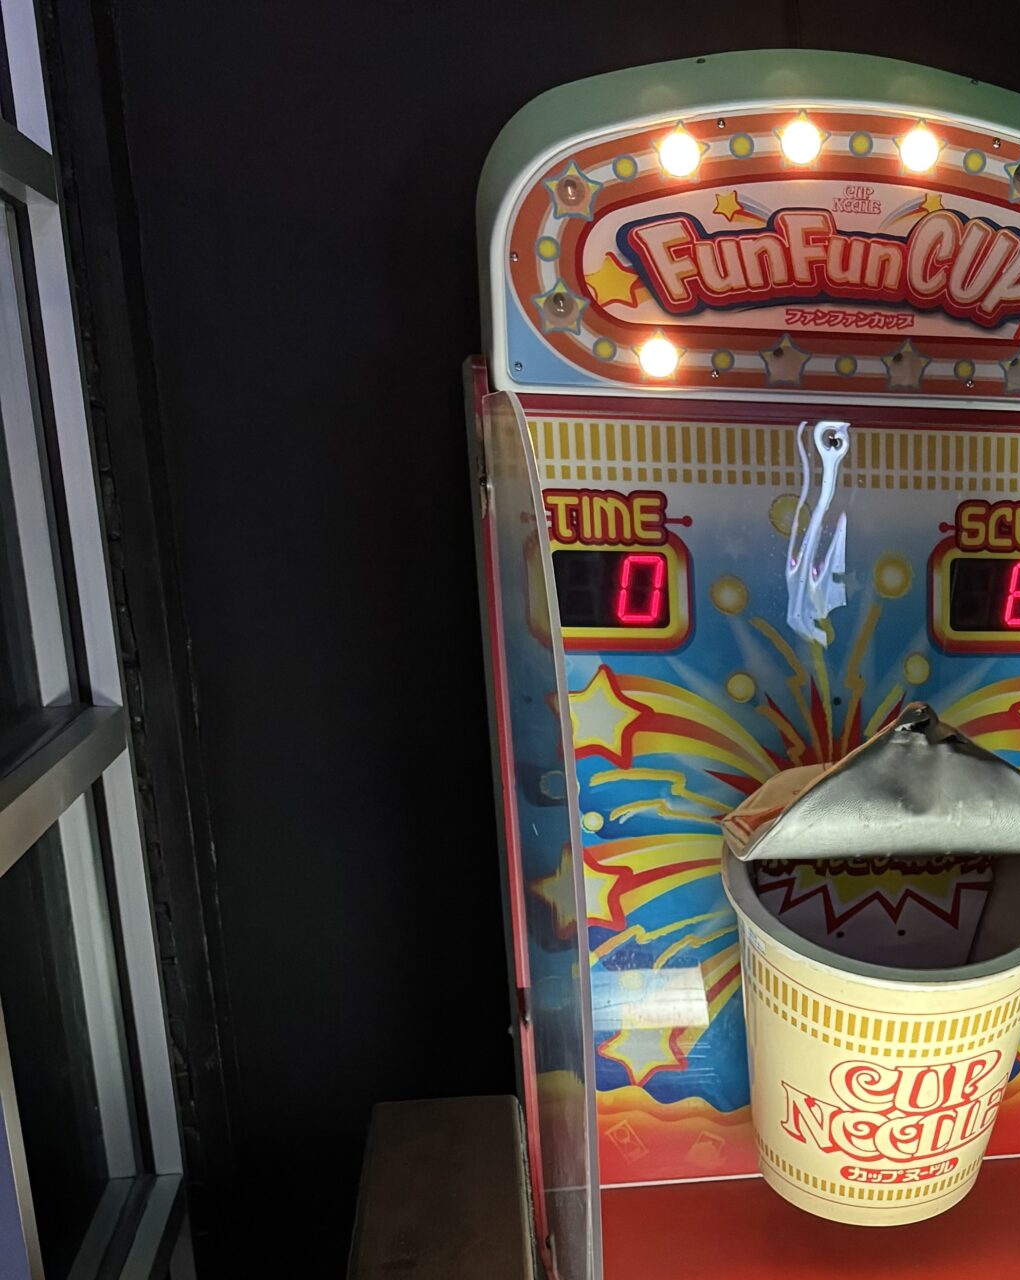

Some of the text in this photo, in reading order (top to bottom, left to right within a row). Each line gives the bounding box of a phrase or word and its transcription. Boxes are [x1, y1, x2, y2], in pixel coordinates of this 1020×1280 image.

[546, 495, 663, 540] TIME
[616, 554, 666, 624] 0
[829, 1049, 1003, 1114] CUP
[847, 1161, 954, 1183] カップヌードル
